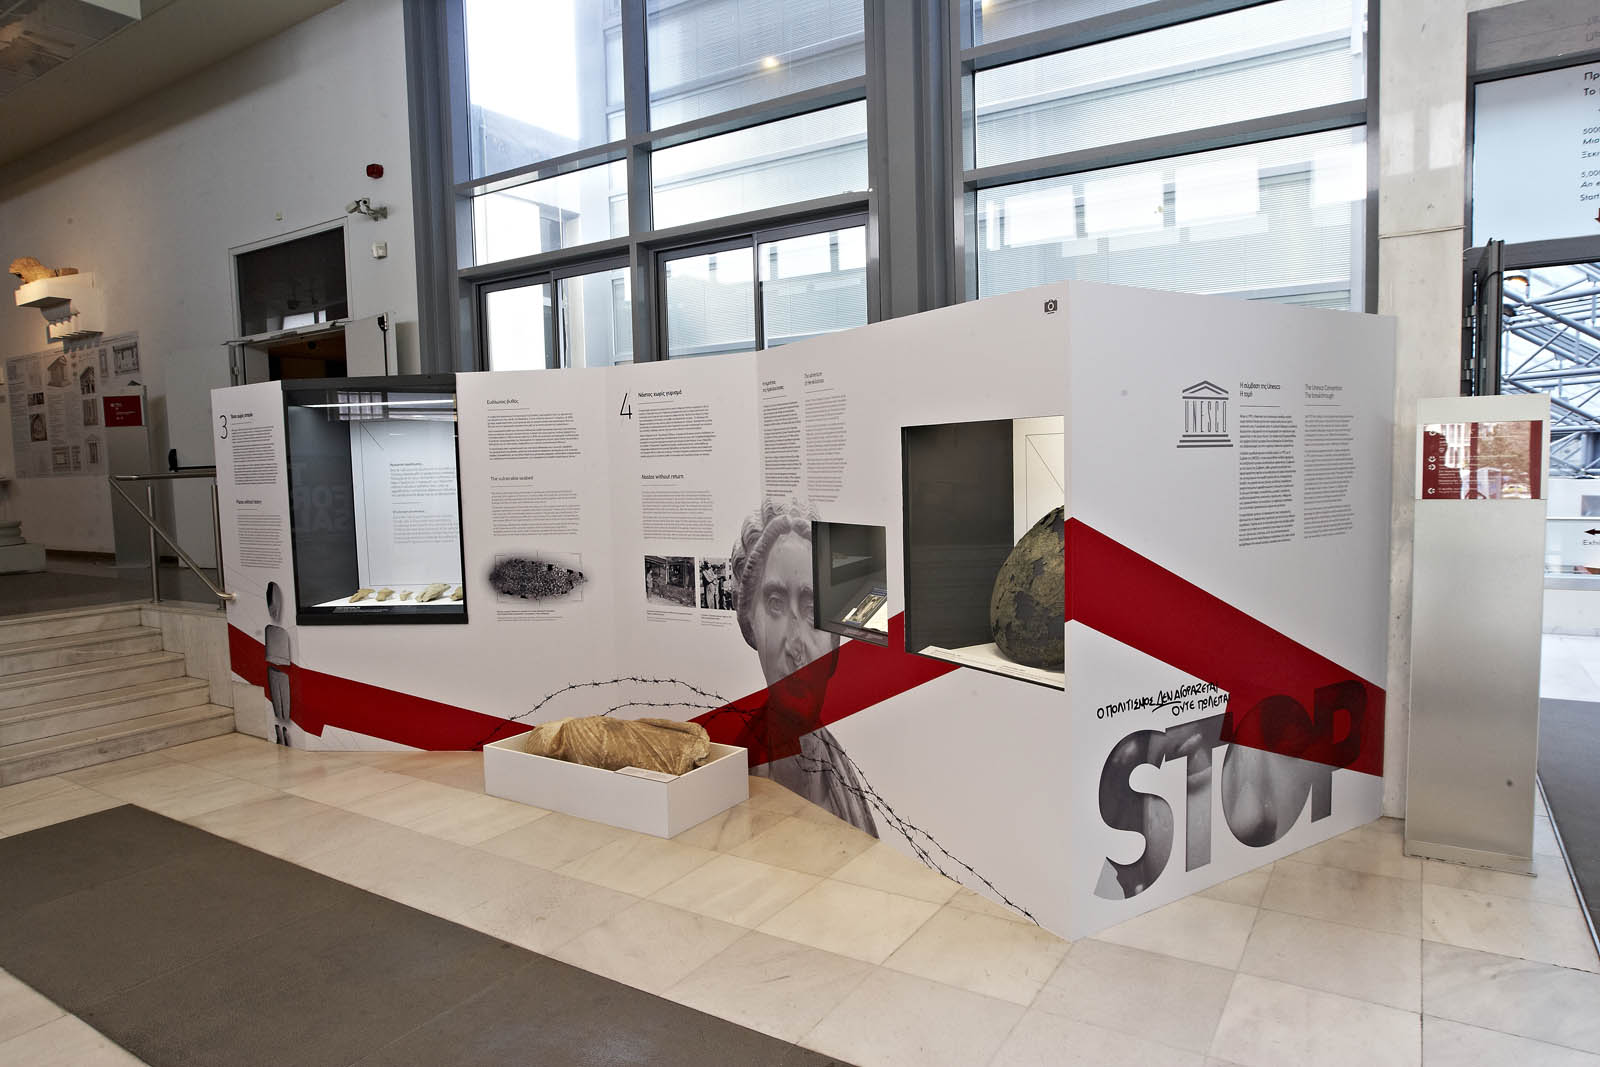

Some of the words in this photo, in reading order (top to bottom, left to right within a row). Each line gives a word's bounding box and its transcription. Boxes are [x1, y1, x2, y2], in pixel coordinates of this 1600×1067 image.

[619, 392, 632, 420] 4
[1184, 400, 1228, 433] UNESCO
[219, 414, 228, 440] 3
[1155, 690, 1173, 708] ΔΕΝ
[1171, 699, 1195, 716] ΟΥΤΕ
[1093, 679, 1369, 901] STOP
